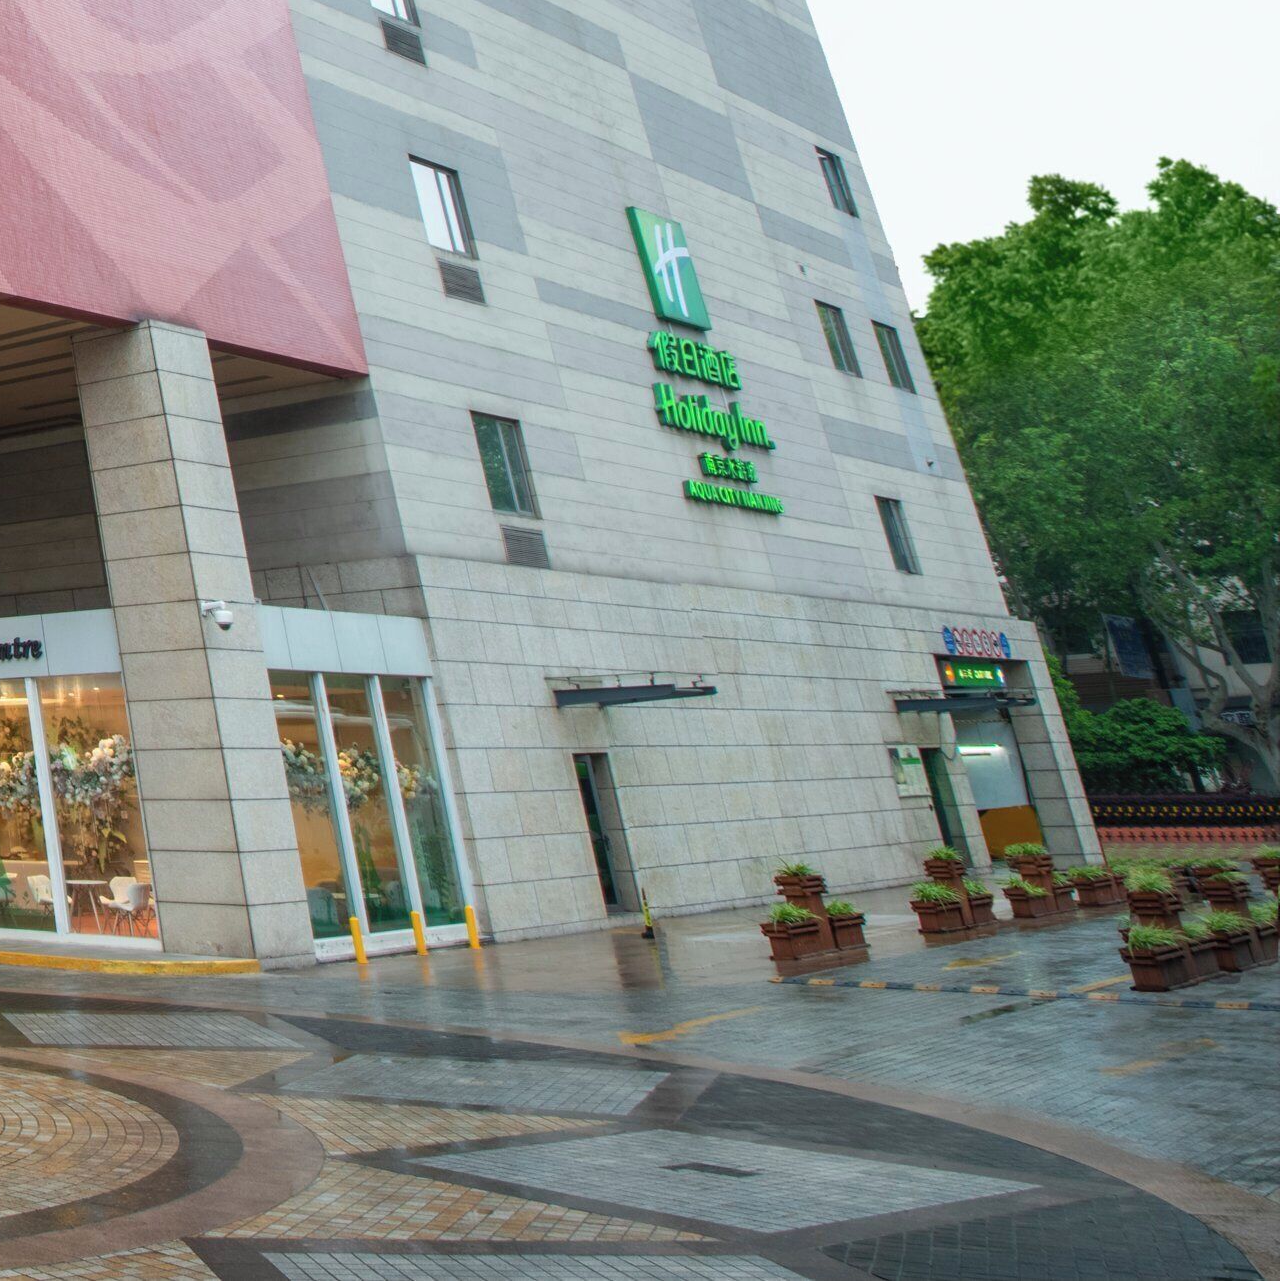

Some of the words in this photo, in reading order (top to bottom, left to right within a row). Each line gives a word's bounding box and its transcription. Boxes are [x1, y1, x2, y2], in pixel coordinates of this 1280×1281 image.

[650, 331, 741, 389] 假日酒店
[653, 383, 739, 450] Holiday
[730, 402, 773, 448] Inn
[686, 479, 721, 502] AQUA
